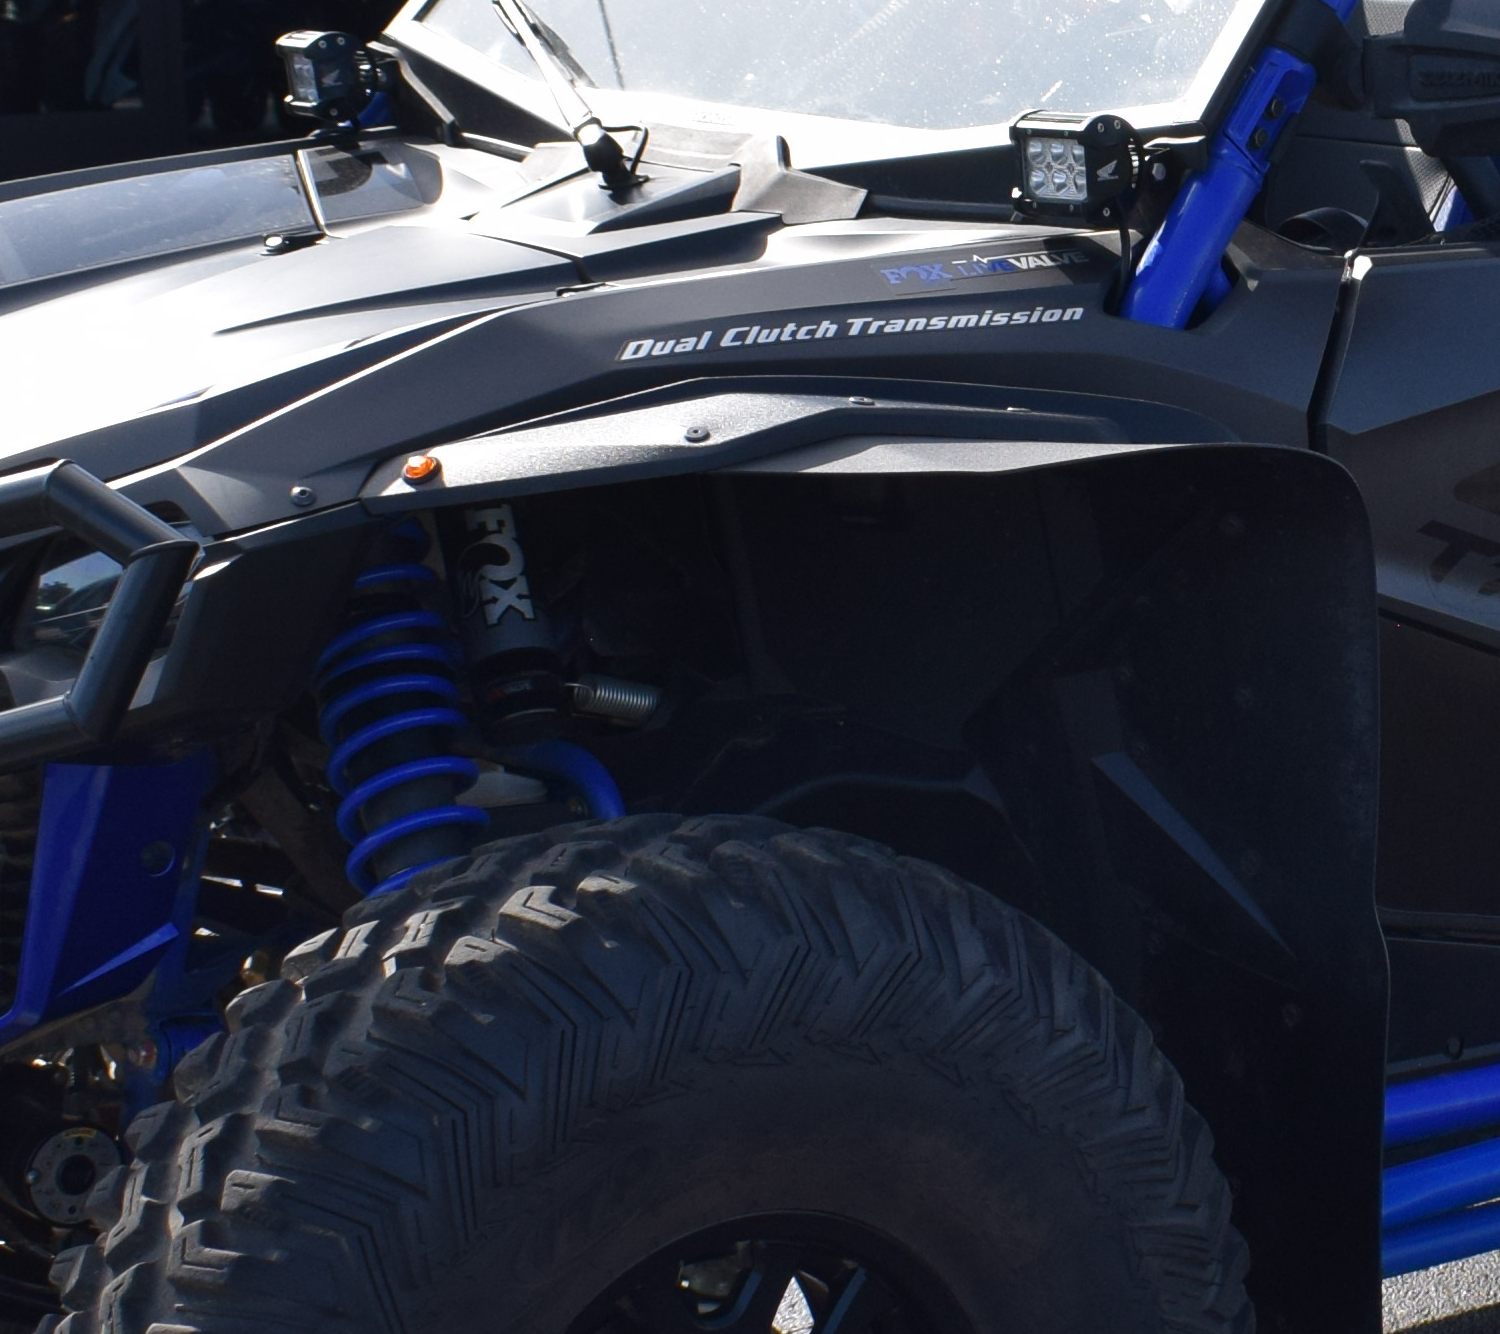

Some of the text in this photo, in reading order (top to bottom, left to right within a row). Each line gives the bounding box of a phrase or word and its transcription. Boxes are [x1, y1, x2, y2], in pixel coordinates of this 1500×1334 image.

[880, 262, 953, 285] FOX
[619, 305, 1084, 362] Dual Clutch Transmission
[457, 503, 535, 626] FOX
